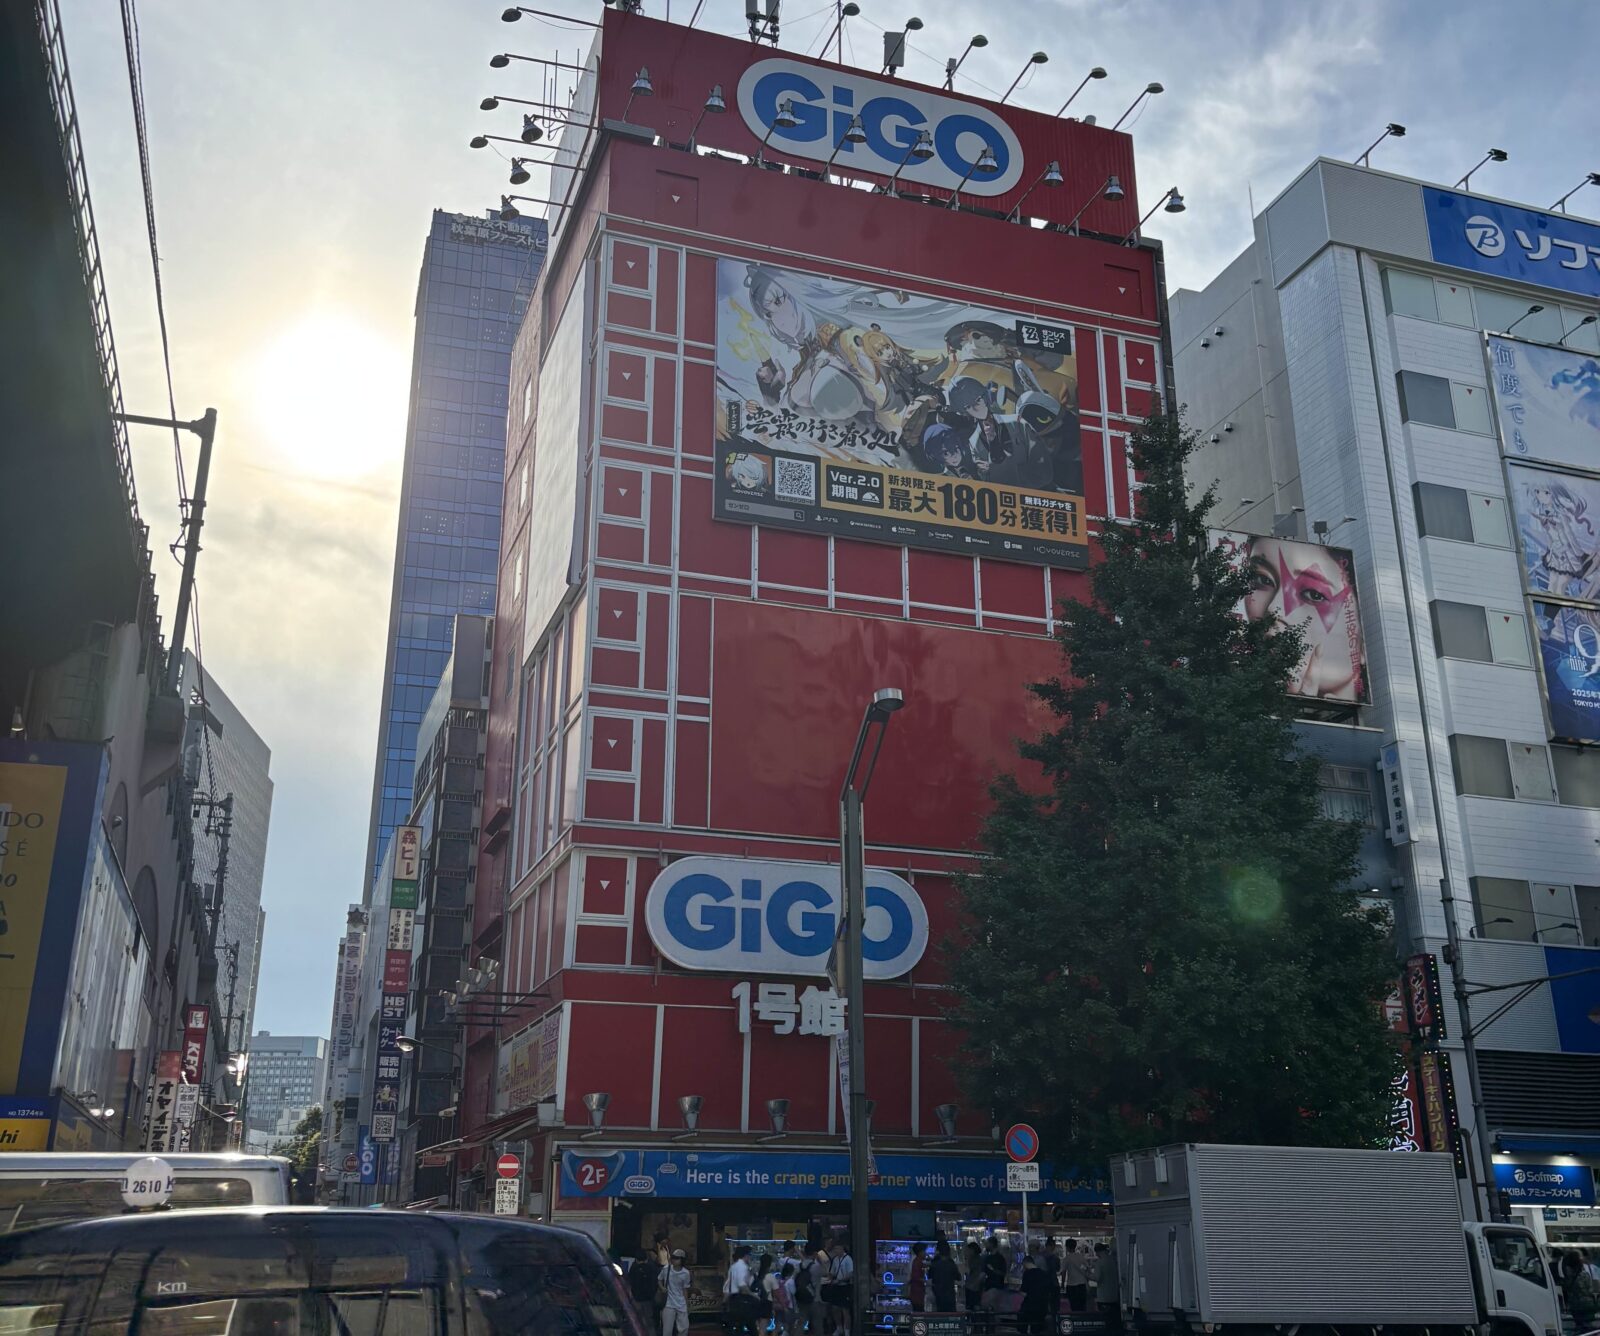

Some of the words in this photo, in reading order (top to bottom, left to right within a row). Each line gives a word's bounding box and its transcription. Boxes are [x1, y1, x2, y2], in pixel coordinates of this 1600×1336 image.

[753, 72, 1010, 183] GiGO
[1042, 329, 1066, 340] ゼンレス
[1043, 341, 1056, 349] ゼロ
[1495, 344, 1527, 454] 何度でも
[829, 469, 880, 488] Ver.2.0
[889, 475, 936, 491] 新規限定
[831, 484, 858, 500] 期間
[889, 488, 938, 516] 最大
[937, 482, 998, 526] 180
[1024, 495, 1072, 512] 無料ガチャを
[1020, 507, 1078, 537] 獲得!
[664, 873, 913, 962] GiGO
[384, 996, 405, 1006] HB
[732, 981, 848, 1036] 1号館
[384, 1008, 404, 1018] ST
[381, 1026, 402, 1037] カード
[184, 1041, 201, 1078] KFC
[379, 1056, 400, 1067] 販売
[378, 1067, 399, 1078] 買取
[1423, 1056, 1445, 1150] ステーキとハンバーグ
[581, 1164, 605, 1186] 2F
[687, 1169, 722, 1184] Here
[728, 1168, 740, 1184] is
[746, 1169, 769, 1184] the
[774, 1173, 815, 1185] crane
[820, 1174, 853, 1190] gam
[916, 1172, 945, 1188] with
[950, 1173, 976, 1188] lots
[981, 1174, 994, 1189] of
[1527, 1171, 1564, 1185] Sofmap
[133, 1180, 162, 1194] 2610
[629, 1180, 650, 1189] GiGO
[1527, 1188, 1582, 1198] アミューズメント館
[157, 1281, 188, 1294] km
